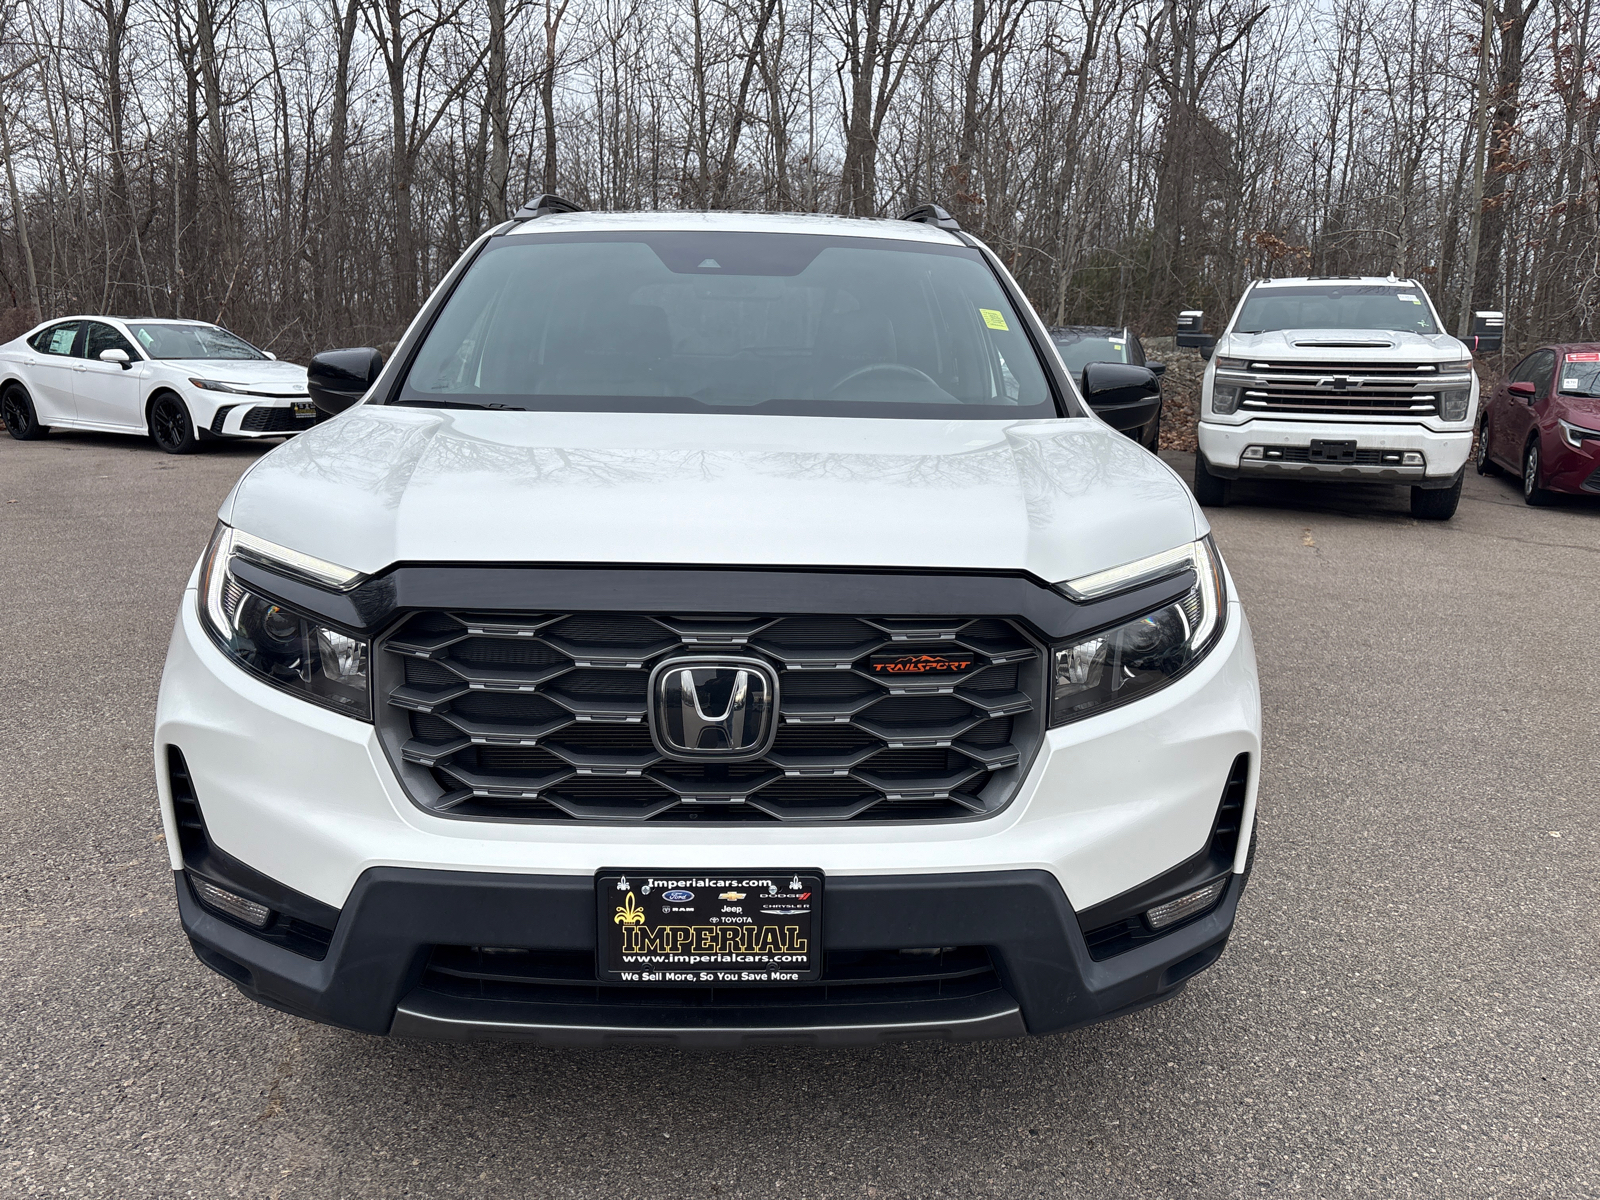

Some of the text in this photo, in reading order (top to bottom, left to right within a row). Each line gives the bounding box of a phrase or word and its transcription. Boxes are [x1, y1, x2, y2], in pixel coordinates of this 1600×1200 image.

[873, 661, 971, 673] TRAILSPORT
[647, 878, 772, 889] Imperialcars.com
[669, 892, 687, 900] Ford
[721, 905, 743, 914] Jeep
[622, 925, 808, 953] IMPERIAL
[622, 953, 808, 964] www.imperialcars.com
[620, 971, 799, 982] We Sell More, So You Save More
